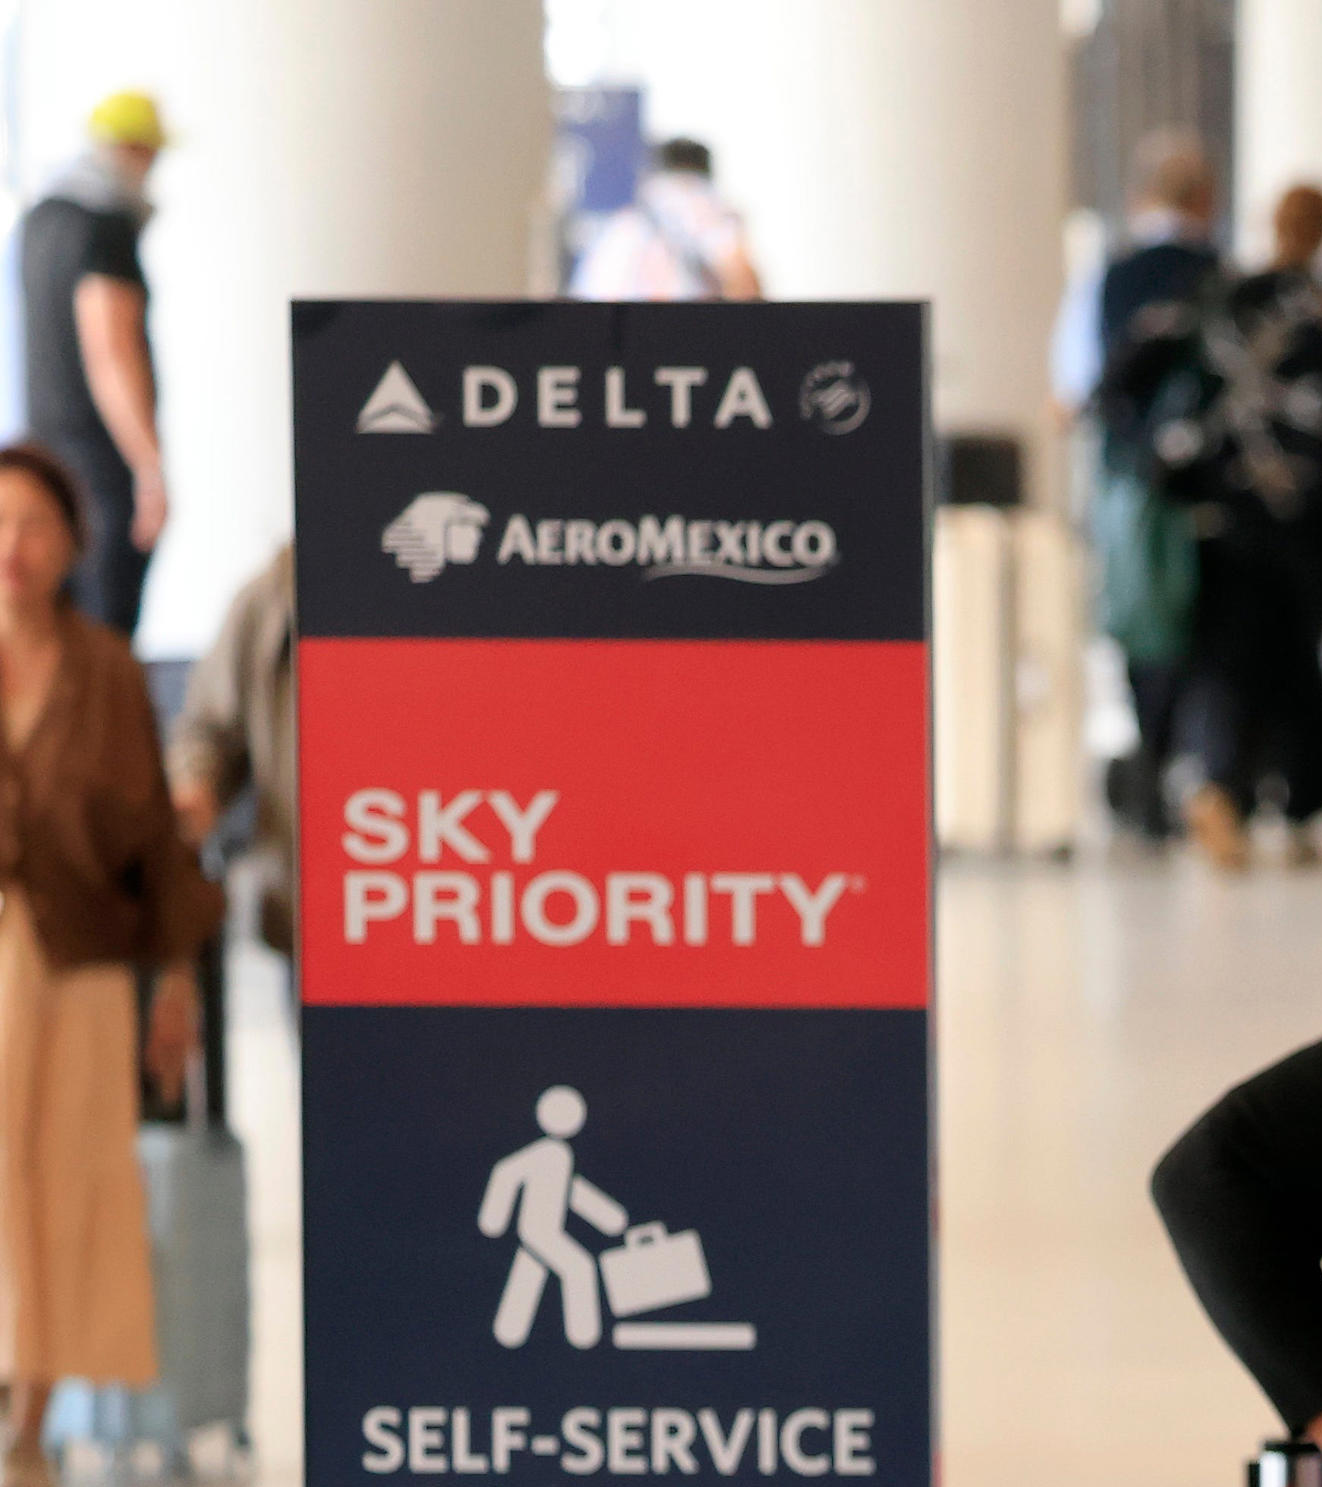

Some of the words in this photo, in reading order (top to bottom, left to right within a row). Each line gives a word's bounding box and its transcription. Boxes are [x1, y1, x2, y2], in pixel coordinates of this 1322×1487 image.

[461, 365, 772, 429] DELTA
[341, 787, 559, 865] SKY
[342, 869, 850, 948] PRIORITY
[360, 1405, 877, 1477] SELF-SERVICE
